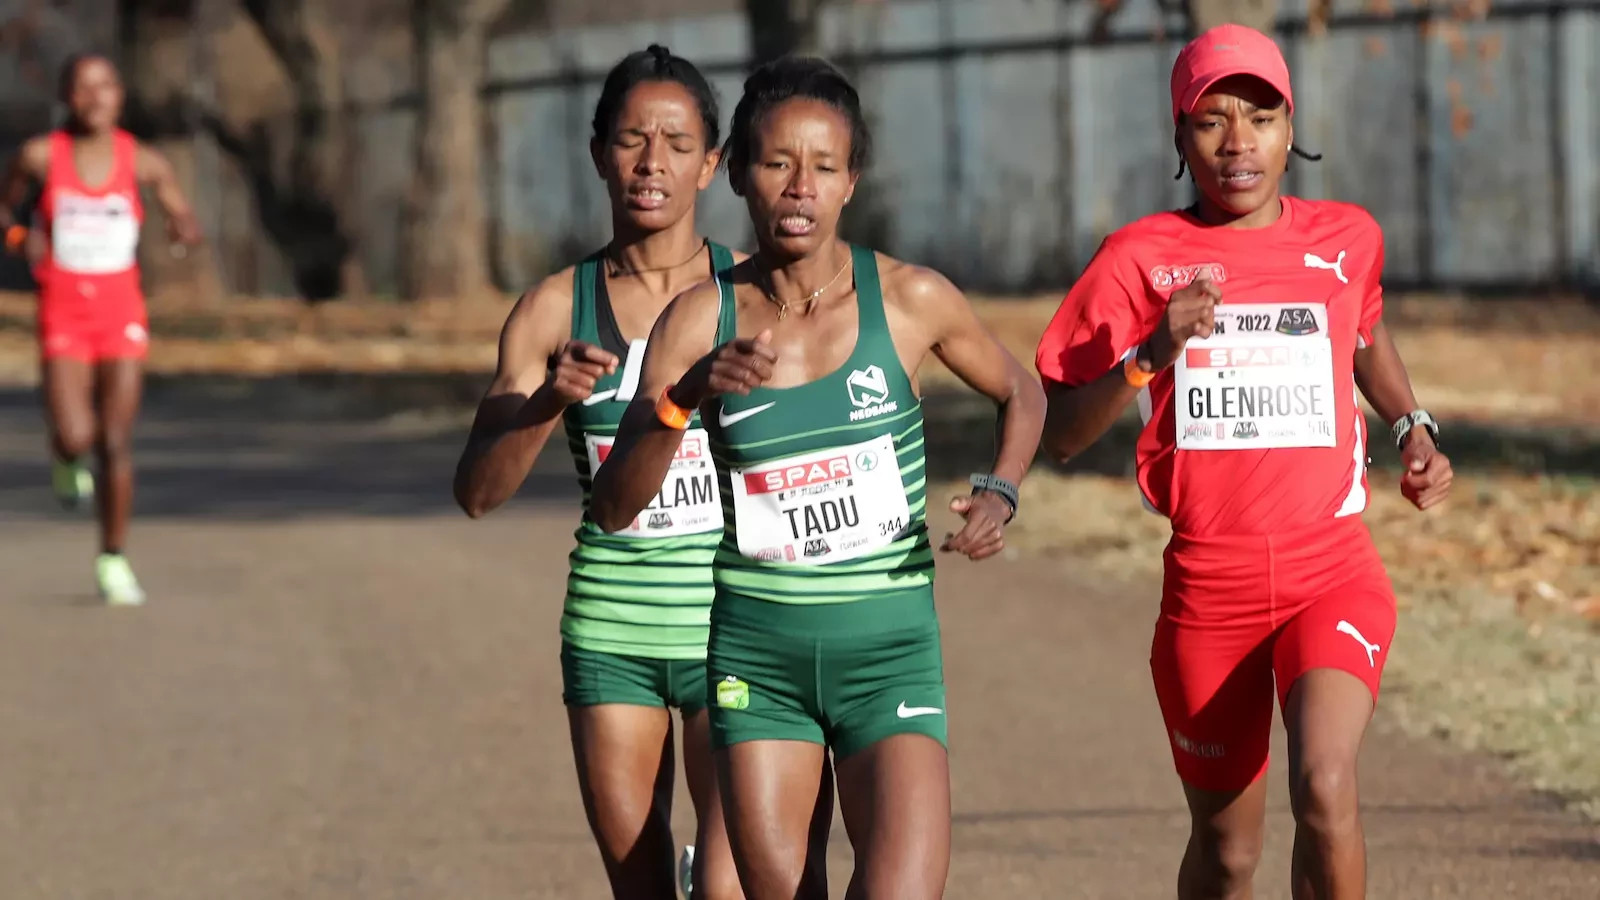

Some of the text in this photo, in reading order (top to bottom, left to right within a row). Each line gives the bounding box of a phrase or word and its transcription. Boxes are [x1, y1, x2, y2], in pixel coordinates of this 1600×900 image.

[1150, 263, 1225, 290] BOXR
[1236, 314, 1271, 332] 2022
[1280, 309, 1315, 325] ASA
[1209, 348, 1288, 367] SPAR
[849, 401, 897, 421] NEDBANK
[1188, 385, 1323, 418] GLENROSE
[764, 457, 851, 491] SPAR
[646, 474, 713, 510] LAM
[782, 495, 860, 540] TADU
[878, 516, 903, 537] 344
